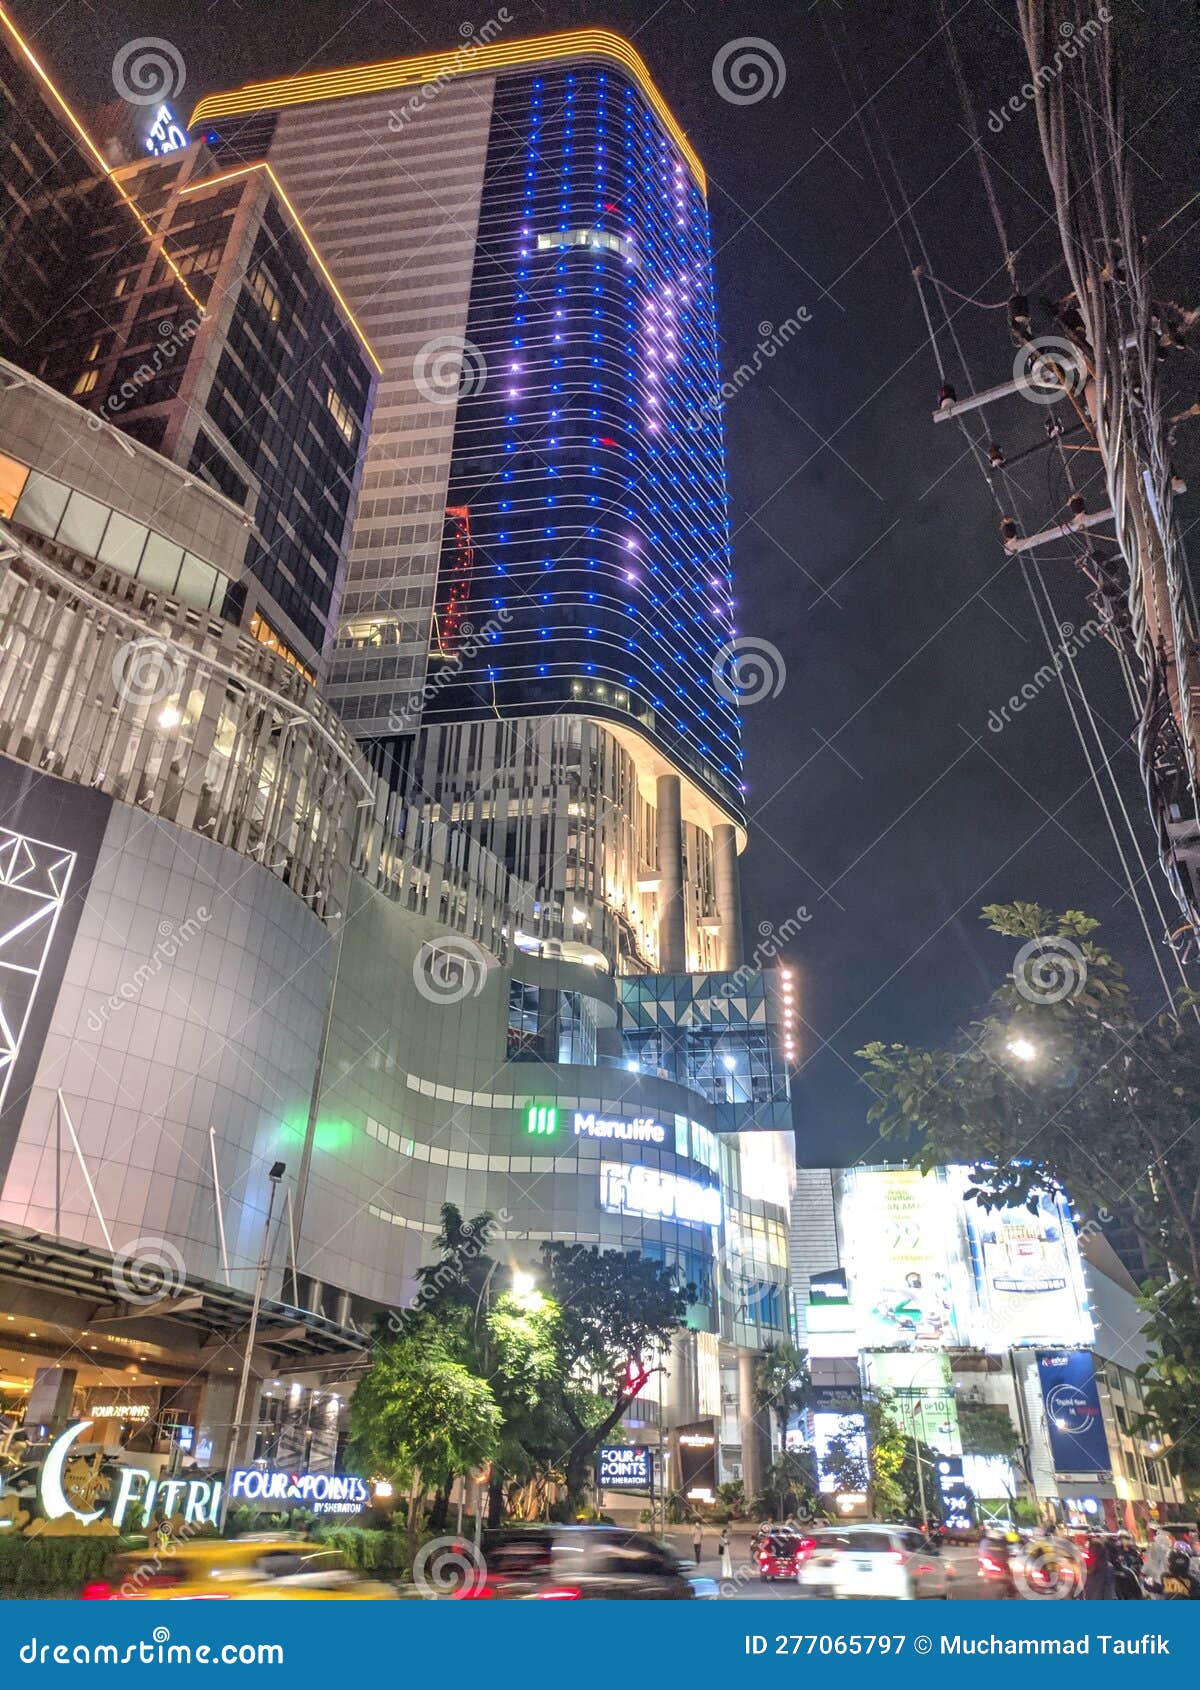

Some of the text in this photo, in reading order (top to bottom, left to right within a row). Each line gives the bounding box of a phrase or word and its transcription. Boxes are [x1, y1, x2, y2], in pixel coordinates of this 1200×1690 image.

[574, 1112, 664, 1143] Manulife
[601, 1449, 634, 1462] FOUR
[601, 1462, 646, 1476] POINTS
[232, 1470, 367, 1501] FOUR POINTS
[601, 1476, 647, 1484] BY SHERATON
[112, 1468, 223, 1528] FITRI
[313, 1502, 362, 1513] BY SHERATON
